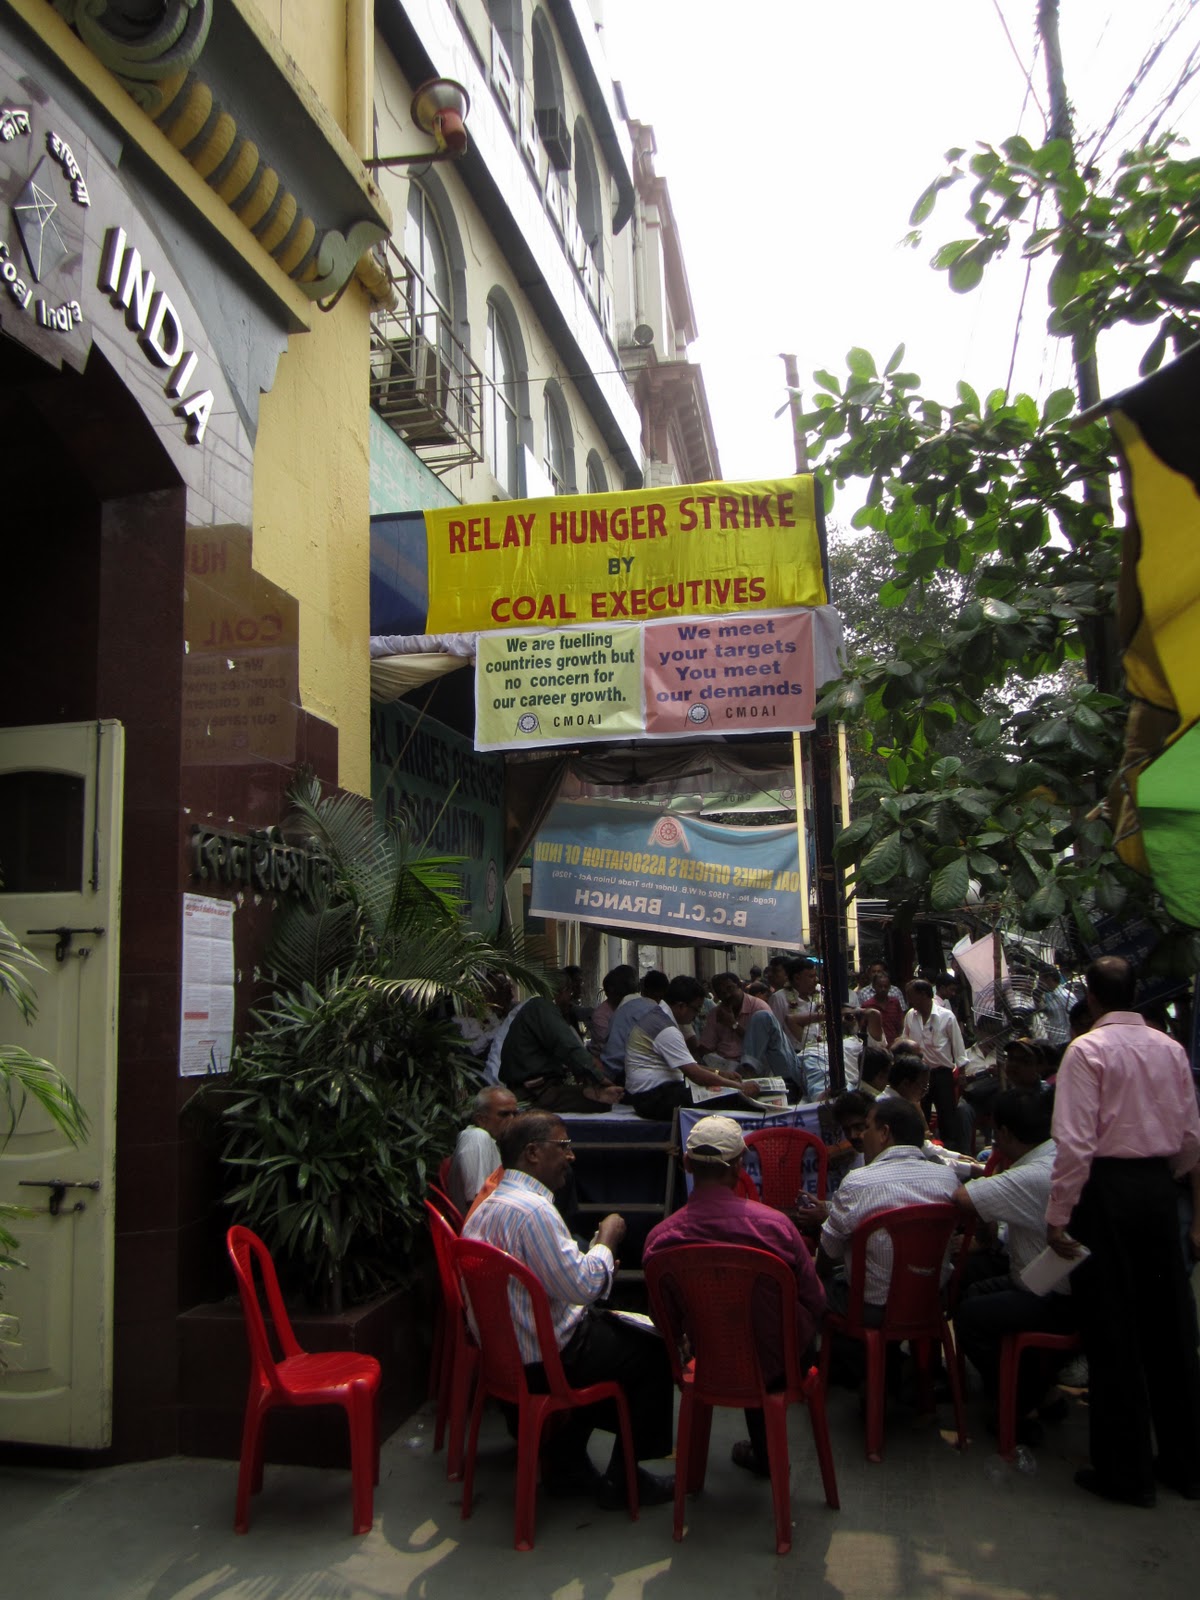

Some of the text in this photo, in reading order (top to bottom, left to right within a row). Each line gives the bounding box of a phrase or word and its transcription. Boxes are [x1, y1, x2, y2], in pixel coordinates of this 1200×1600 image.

[39, 299, 83, 332] India
[105, 227, 214, 444] INDIA
[448, 492, 796, 554] RELAY HUNGER STRIKE
[608, 556, 634, 576] BY
[491, 577, 766, 623] COAL EXECUTIVES
[677, 619, 775, 641] We meet
[506, 631, 613, 654] We are fuelling
[658, 637, 797, 666] your targets
[485, 648, 636, 674] countries growth but
[675, 660, 781, 682] You meet
[504, 668, 615, 690] no concern for
[492, 684, 626, 710] our career growth.
[656, 680, 803, 703] our demands
[553, 713, 603, 729] CMOAI
[724, 704, 777, 719] CMOAI
[396, 720, 449, 790] MINES
